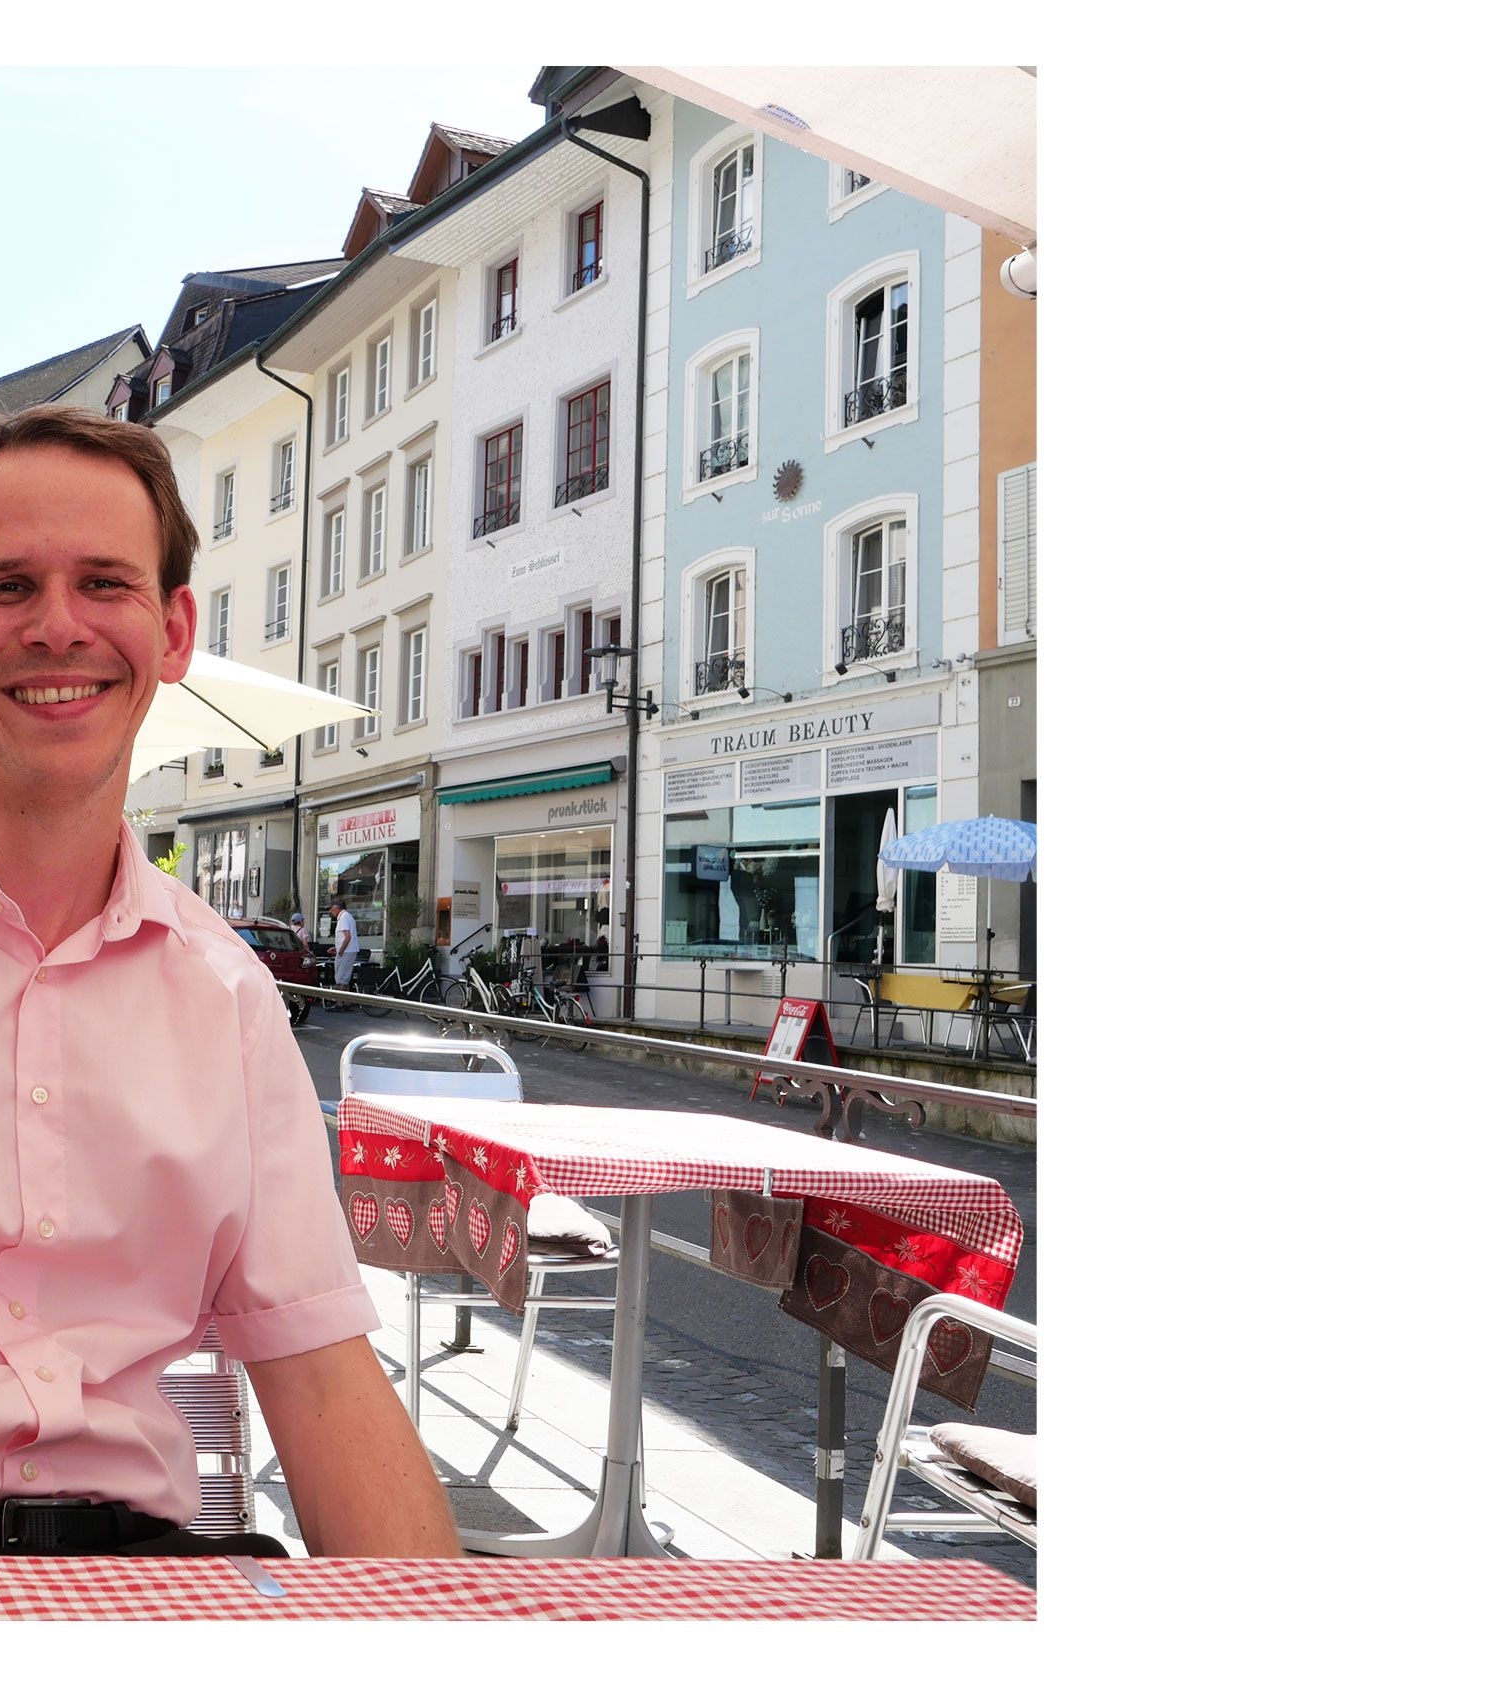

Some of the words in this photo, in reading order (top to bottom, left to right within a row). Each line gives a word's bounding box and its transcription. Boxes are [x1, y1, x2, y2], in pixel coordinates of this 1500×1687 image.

[782, 500, 822, 522] Sonne
[711, 729, 776, 755] TRAUM
[788, 711, 874, 742] BEAUTY
[831, 745, 874, 756] HAARENTFERNUNG
[878, 740, 912, 750] DIODENLASER
[831, 753, 865, 763] KRYOLIPOLYSE
[831, 760, 865, 769] VERSCHIEDENE
[867, 757, 893, 765] MASSAGEN
[338, 809, 396, 832] PIZZERIA
[547, 798, 608, 823] prunkstück
[337, 824, 396, 847] FULMINE
